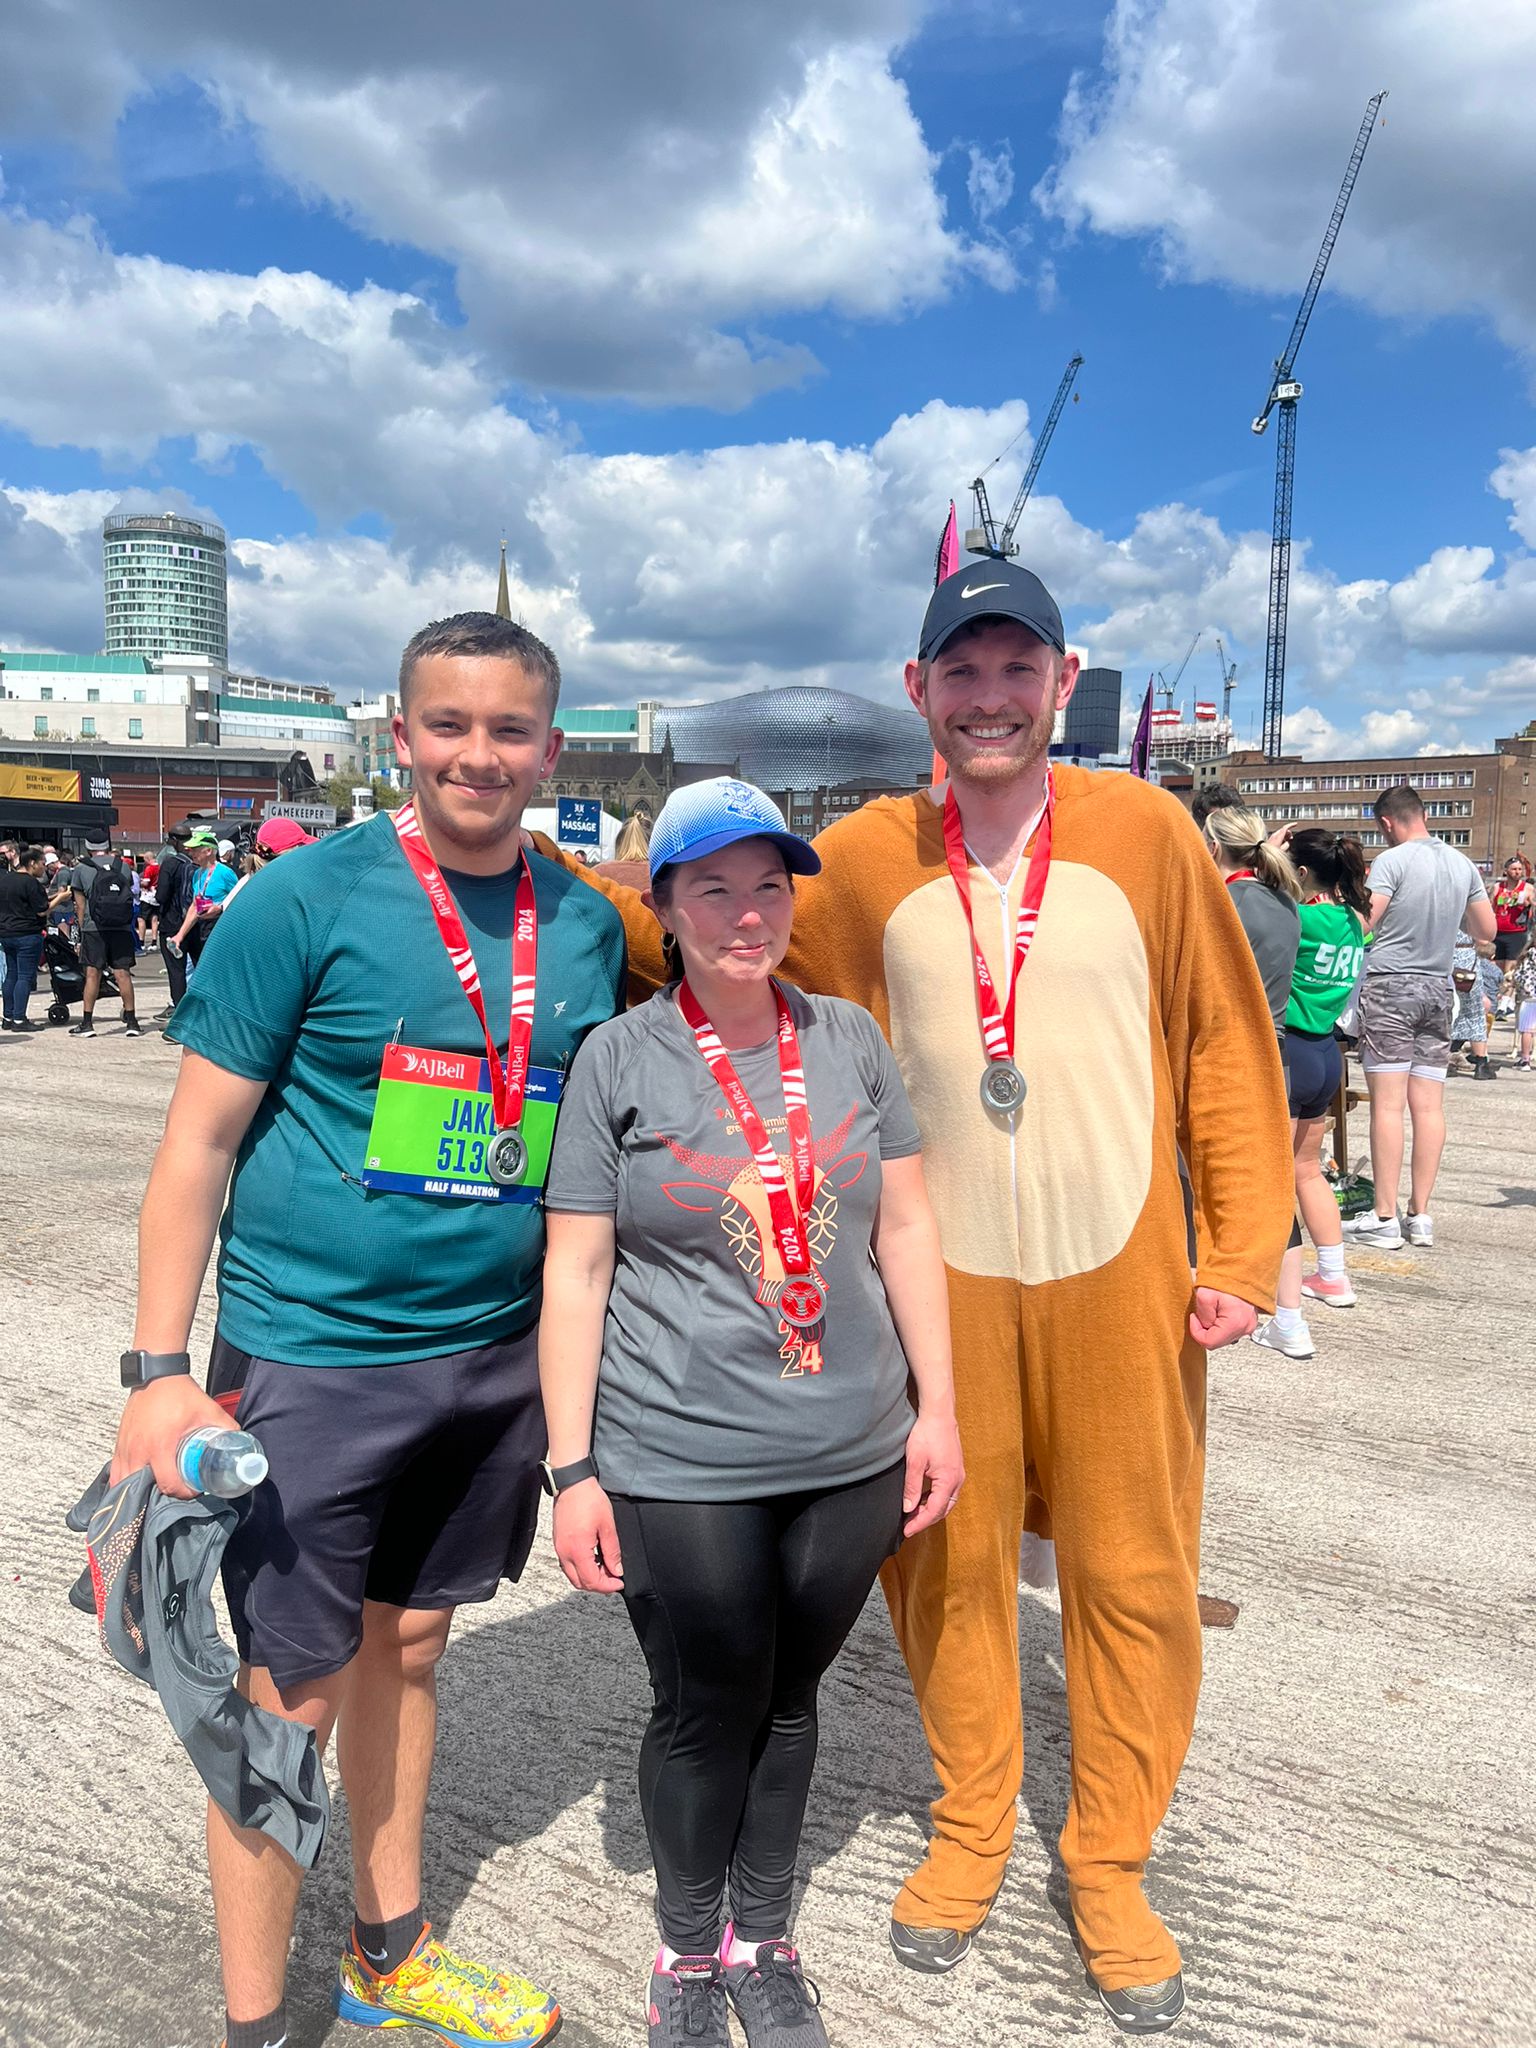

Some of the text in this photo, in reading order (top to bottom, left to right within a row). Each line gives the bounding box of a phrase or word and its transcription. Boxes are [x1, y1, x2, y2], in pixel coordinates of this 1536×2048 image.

[90, 788, 112, 799] TONIC
[271, 806, 325, 819] GAMEKEEPER
[561, 820, 597, 832] MASSAGE
[517, 909, 534, 942] 2024
[437, 1137, 490, 1175] 513
[424, 1180, 500, 1198] HALF MARATHON
[780, 1227, 803, 1264] 2024
[780, 1345, 824, 1378] 24
